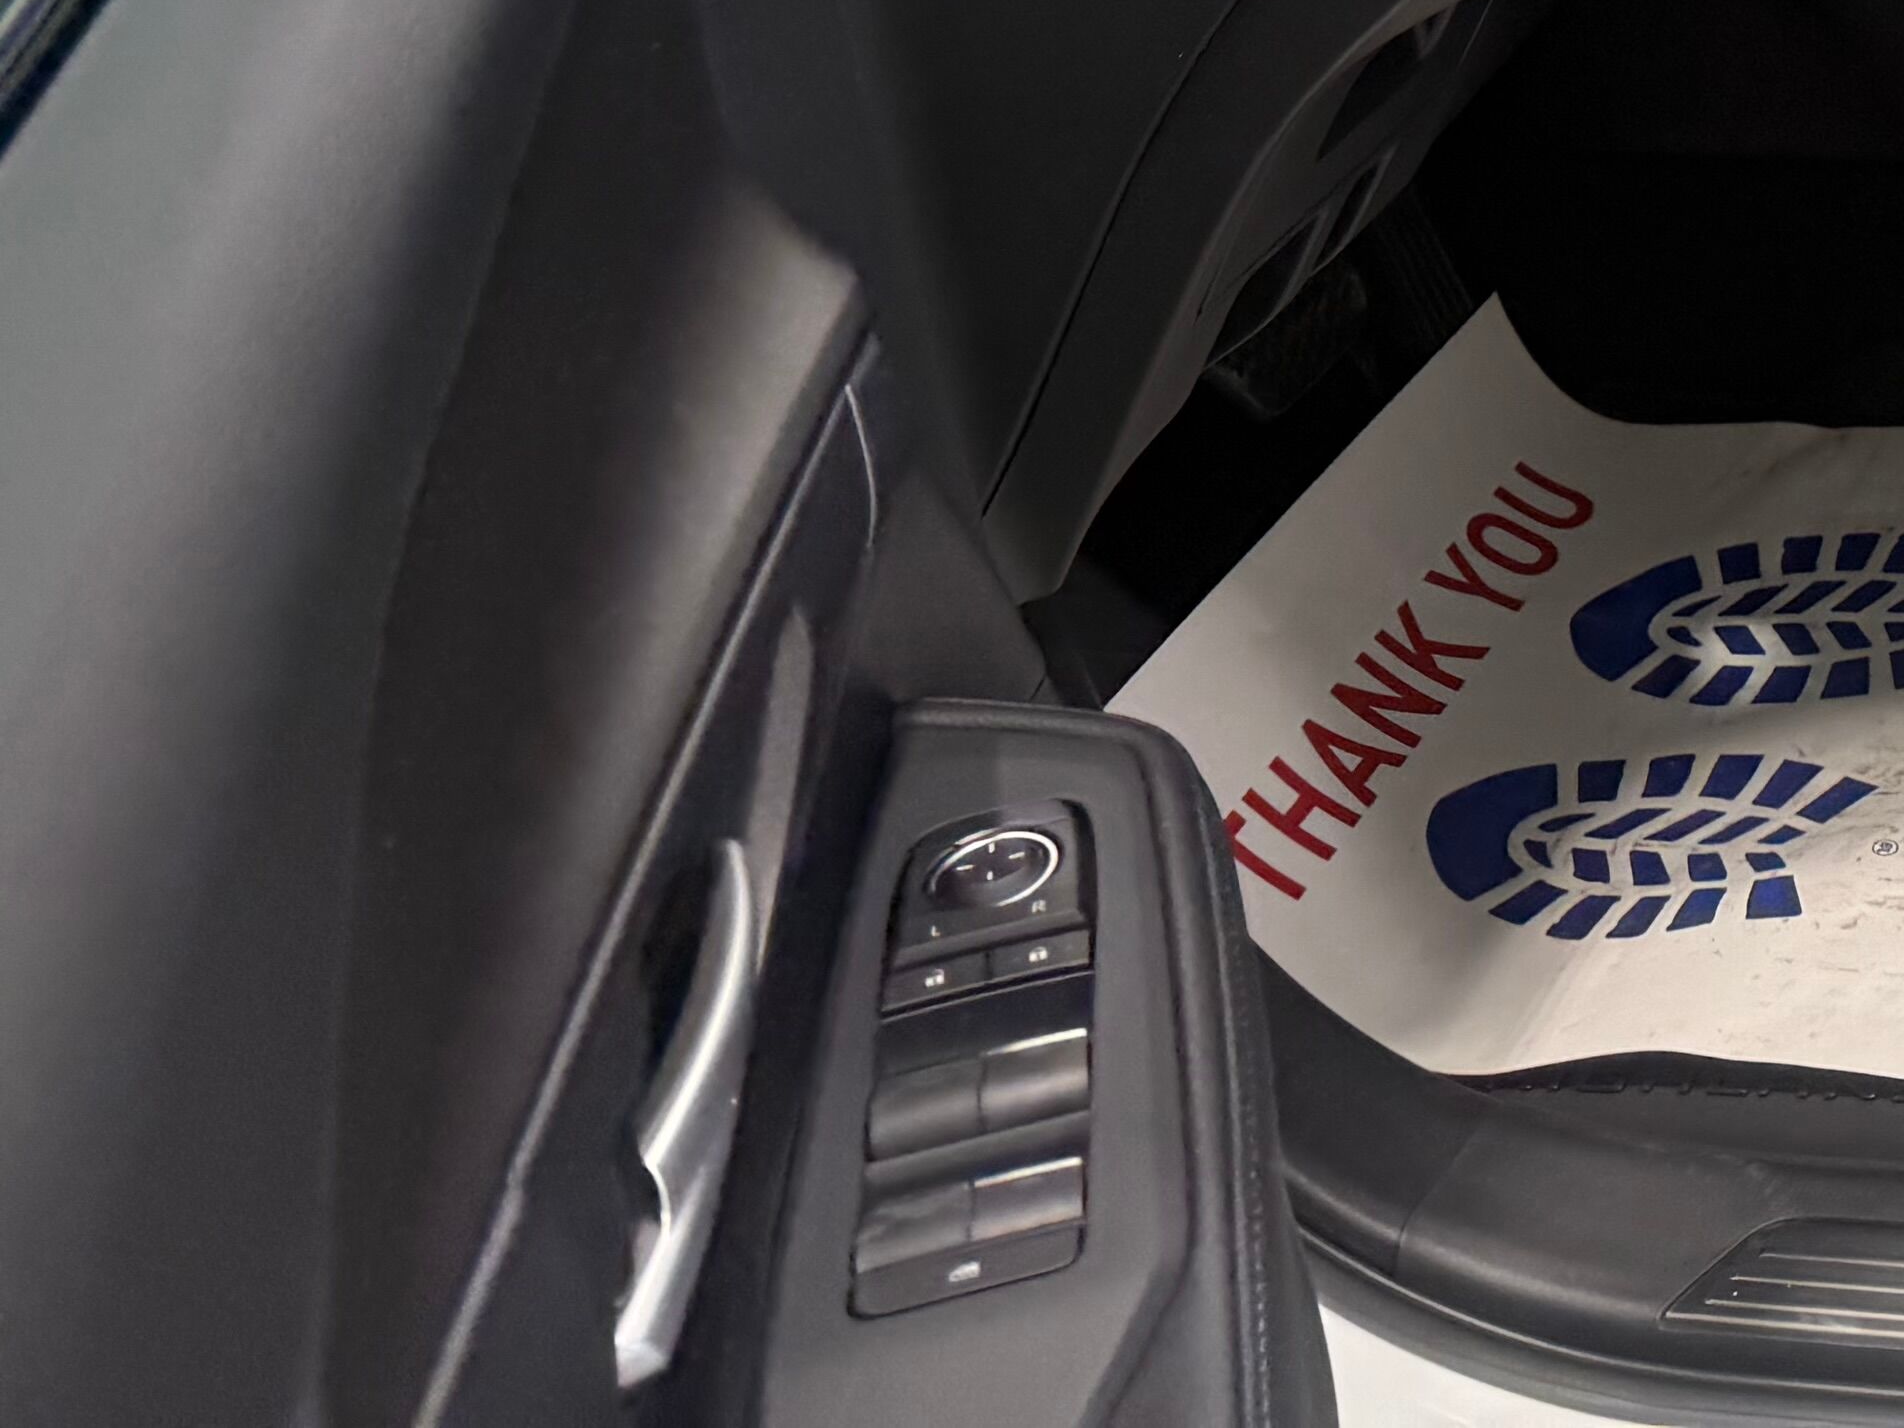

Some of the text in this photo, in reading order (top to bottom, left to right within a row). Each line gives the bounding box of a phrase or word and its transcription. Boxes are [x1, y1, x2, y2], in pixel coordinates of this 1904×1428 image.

[1222, 460, 1595, 901] THANK YOU
[1031, 899, 1046, 913] R
[930, 925, 941, 937] L
